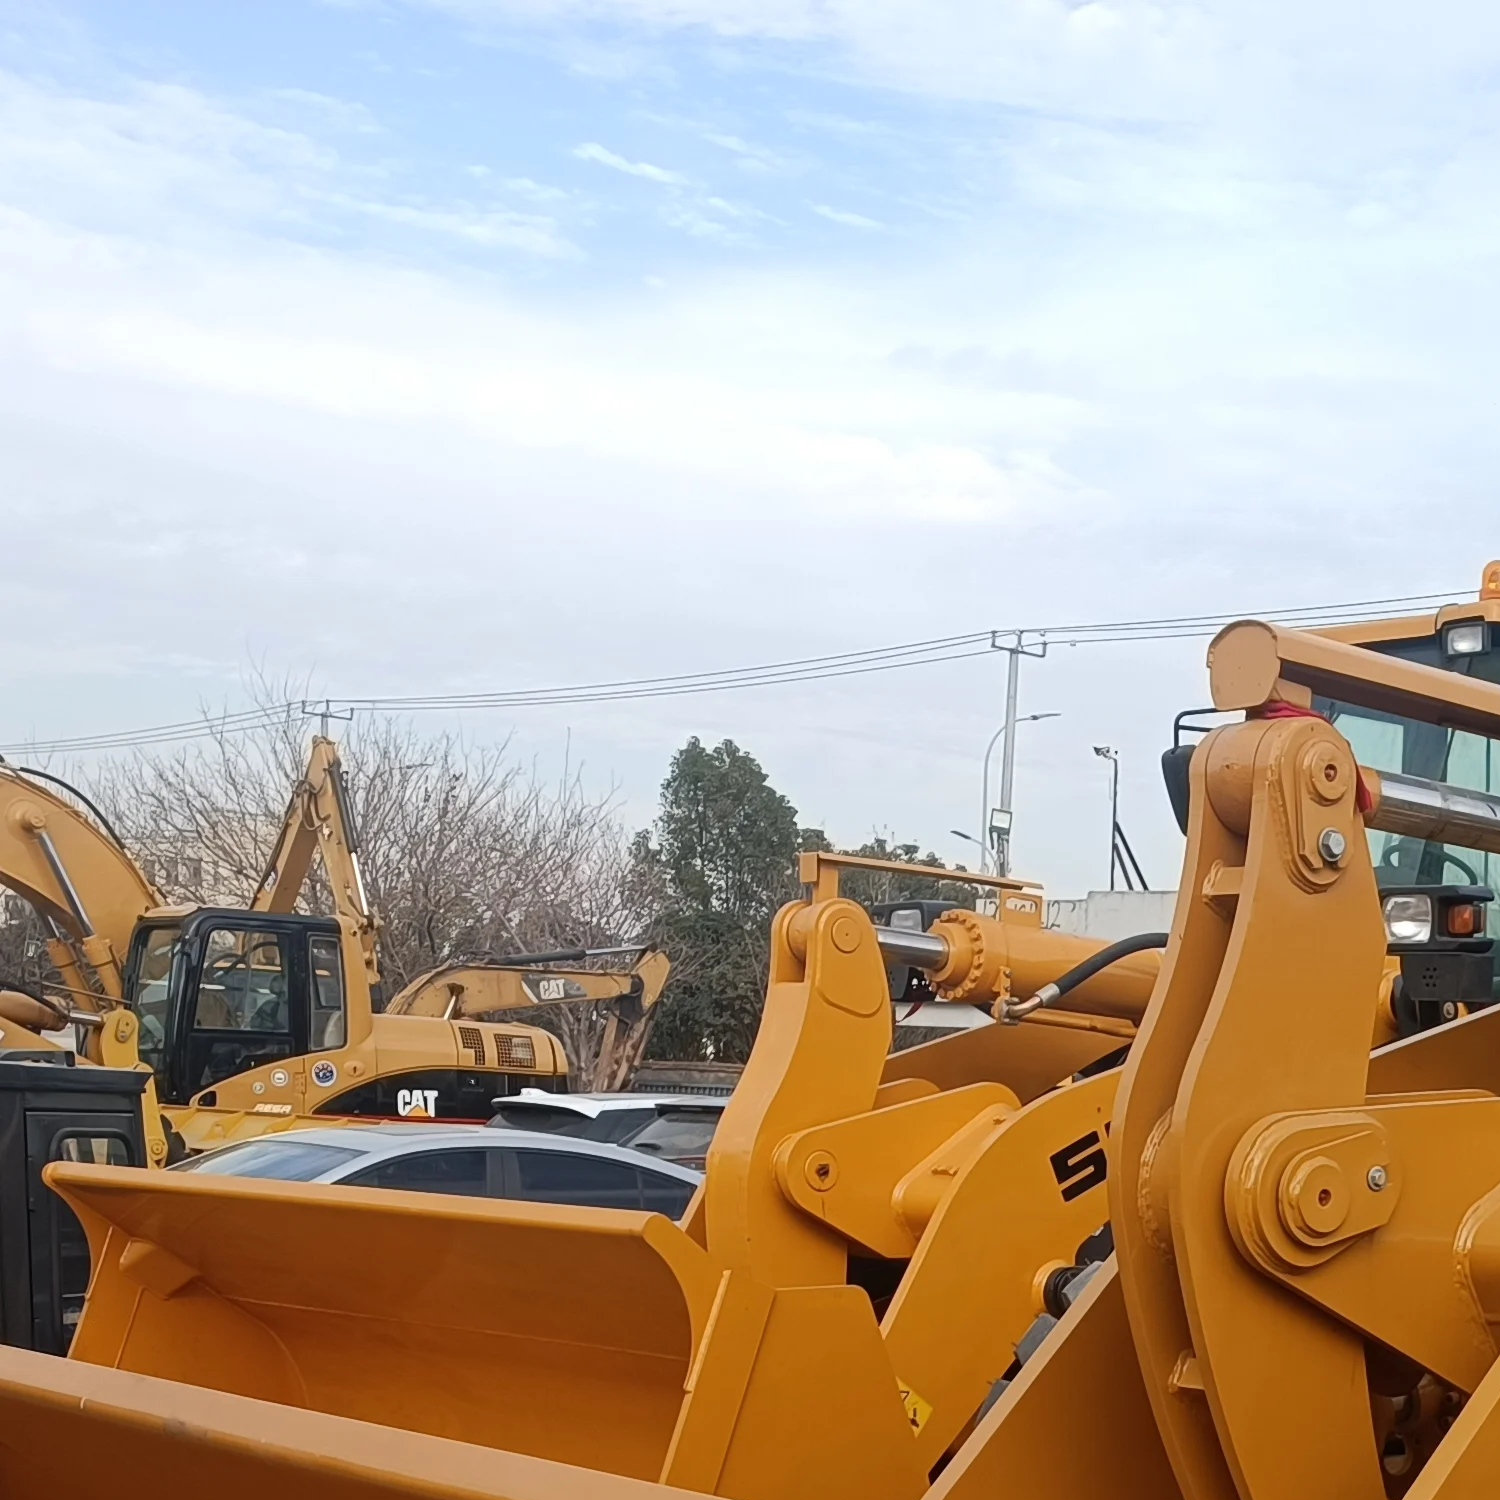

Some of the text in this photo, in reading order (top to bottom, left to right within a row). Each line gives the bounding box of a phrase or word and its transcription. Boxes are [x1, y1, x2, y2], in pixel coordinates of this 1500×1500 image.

[539, 978, 565, 1000] CAT
[397, 1089, 439, 1118] CAT
[1049, 1120, 1111, 1203] S
